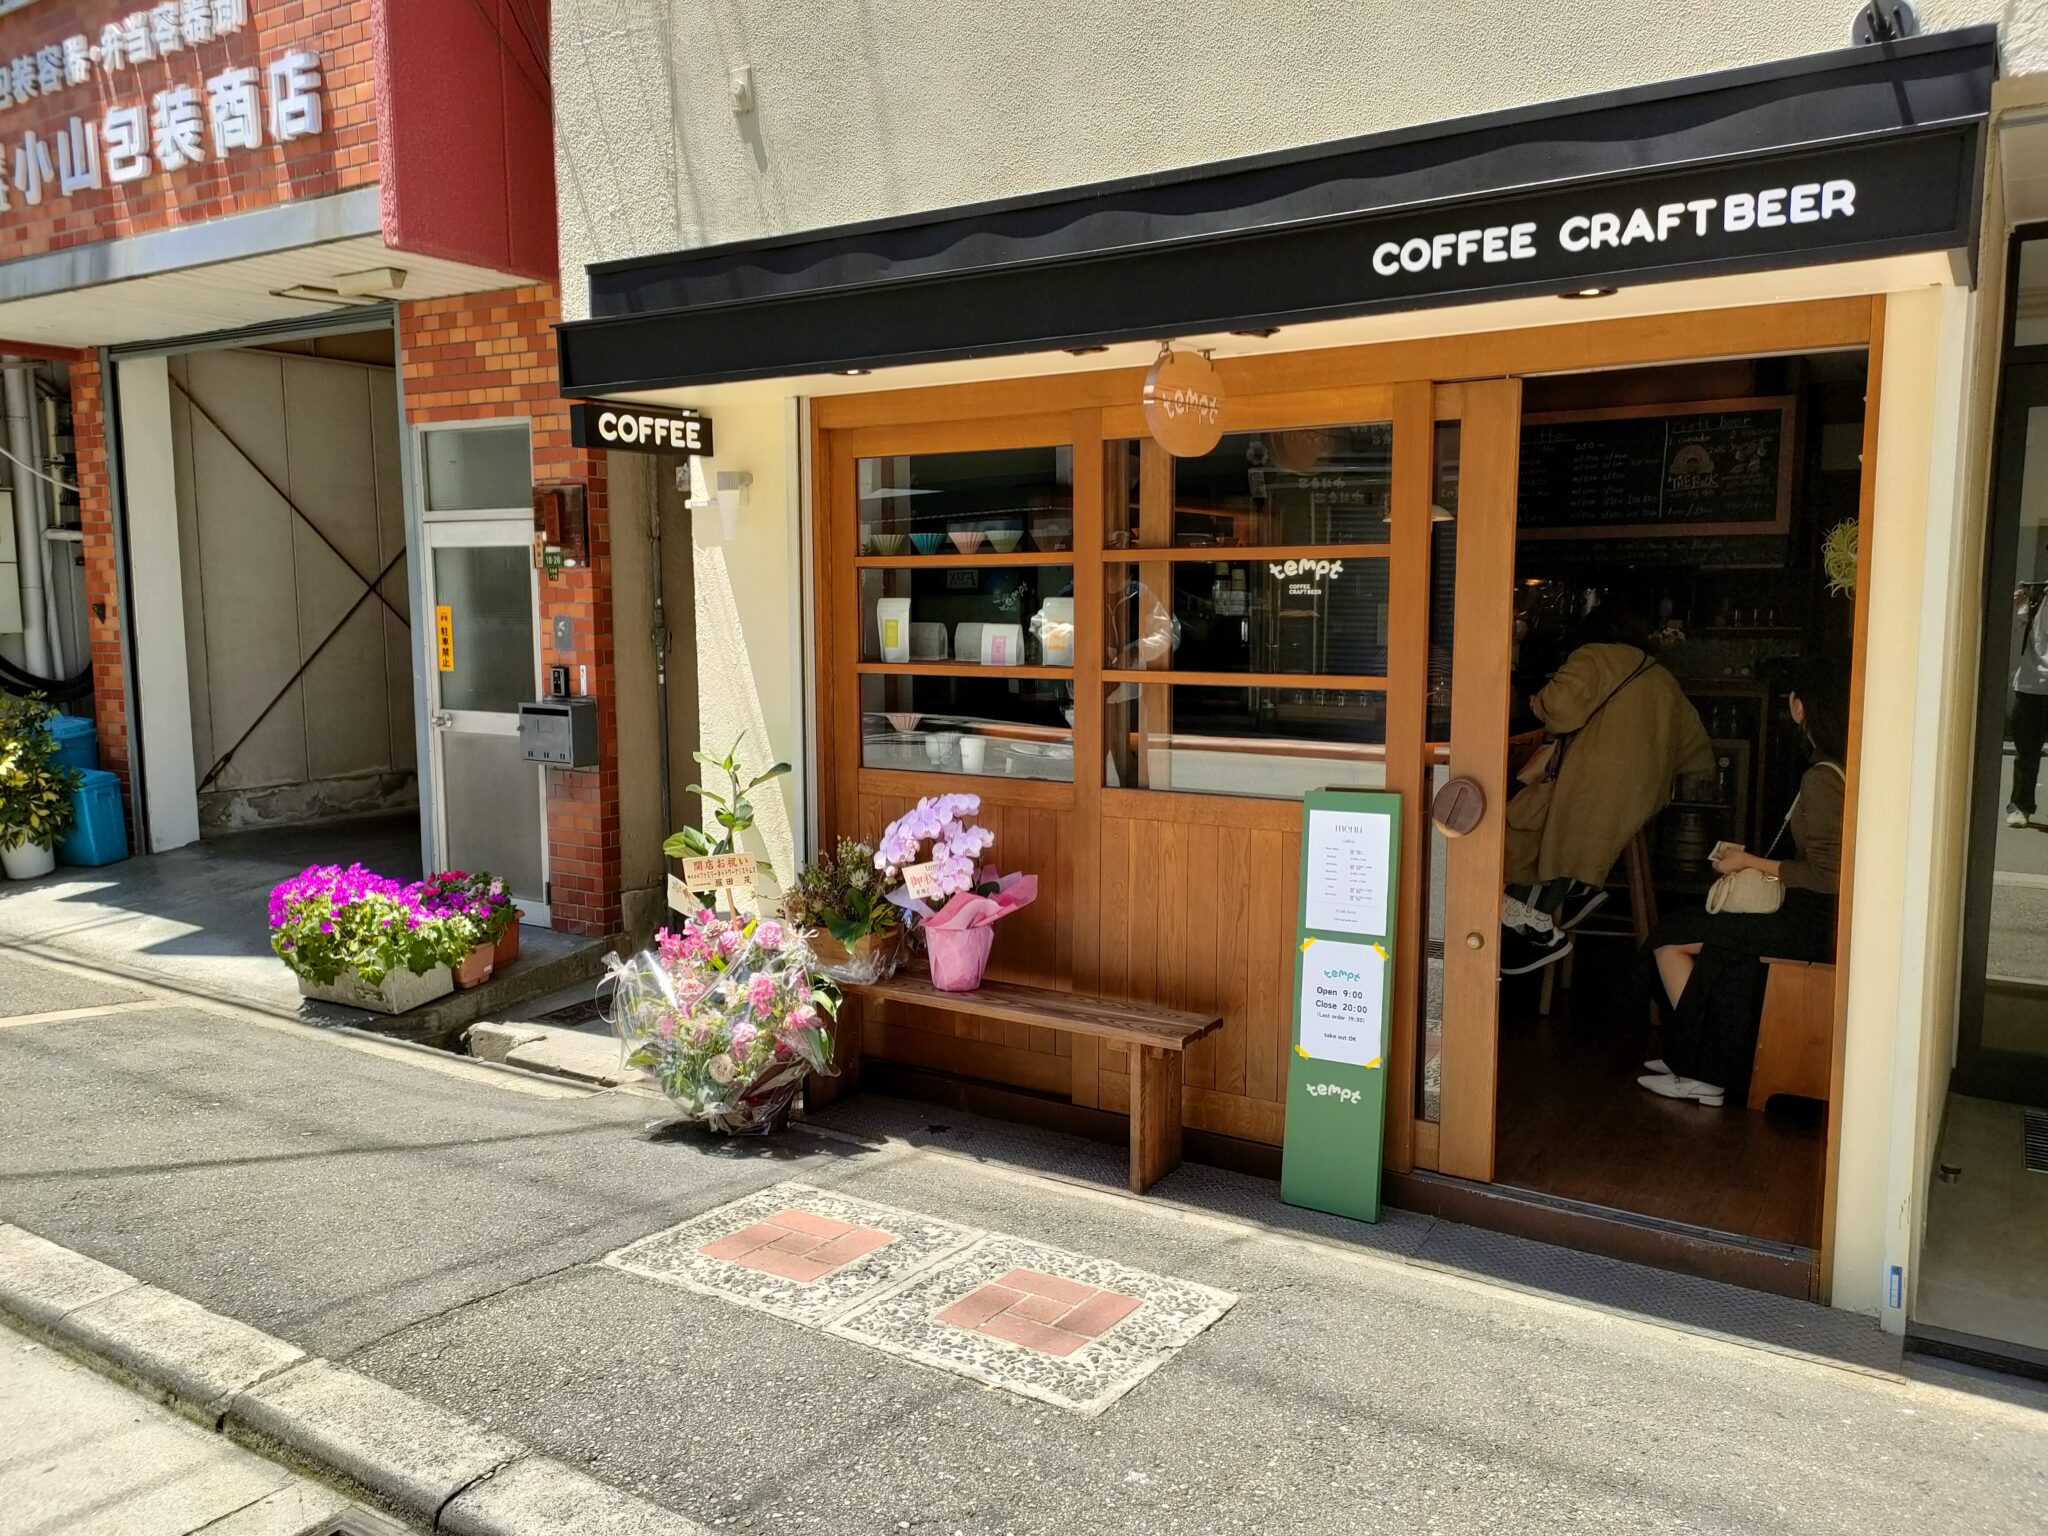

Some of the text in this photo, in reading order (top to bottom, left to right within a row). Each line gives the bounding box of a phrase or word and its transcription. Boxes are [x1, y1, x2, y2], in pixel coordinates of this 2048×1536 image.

[0, 49, 323, 212] 小山包装商店
[1372, 179, 1856, 276] COFFEE CRAFT BEER
[1162, 388, 1218, 425] tempt
[598, 412, 702, 449] COFFEE
[1268, 559, 1343, 580] tempt
[441, 626, 451, 667] 駐車禁止
[693, 857, 749, 871] 開店お祝い
[1323, 969, 1361, 982] tempt
[1316, 986, 1363, 999] Open 9:00
[1315, 999, 1368, 1014] Close 20:00
[1306, 1083, 1362, 1104] tempt
